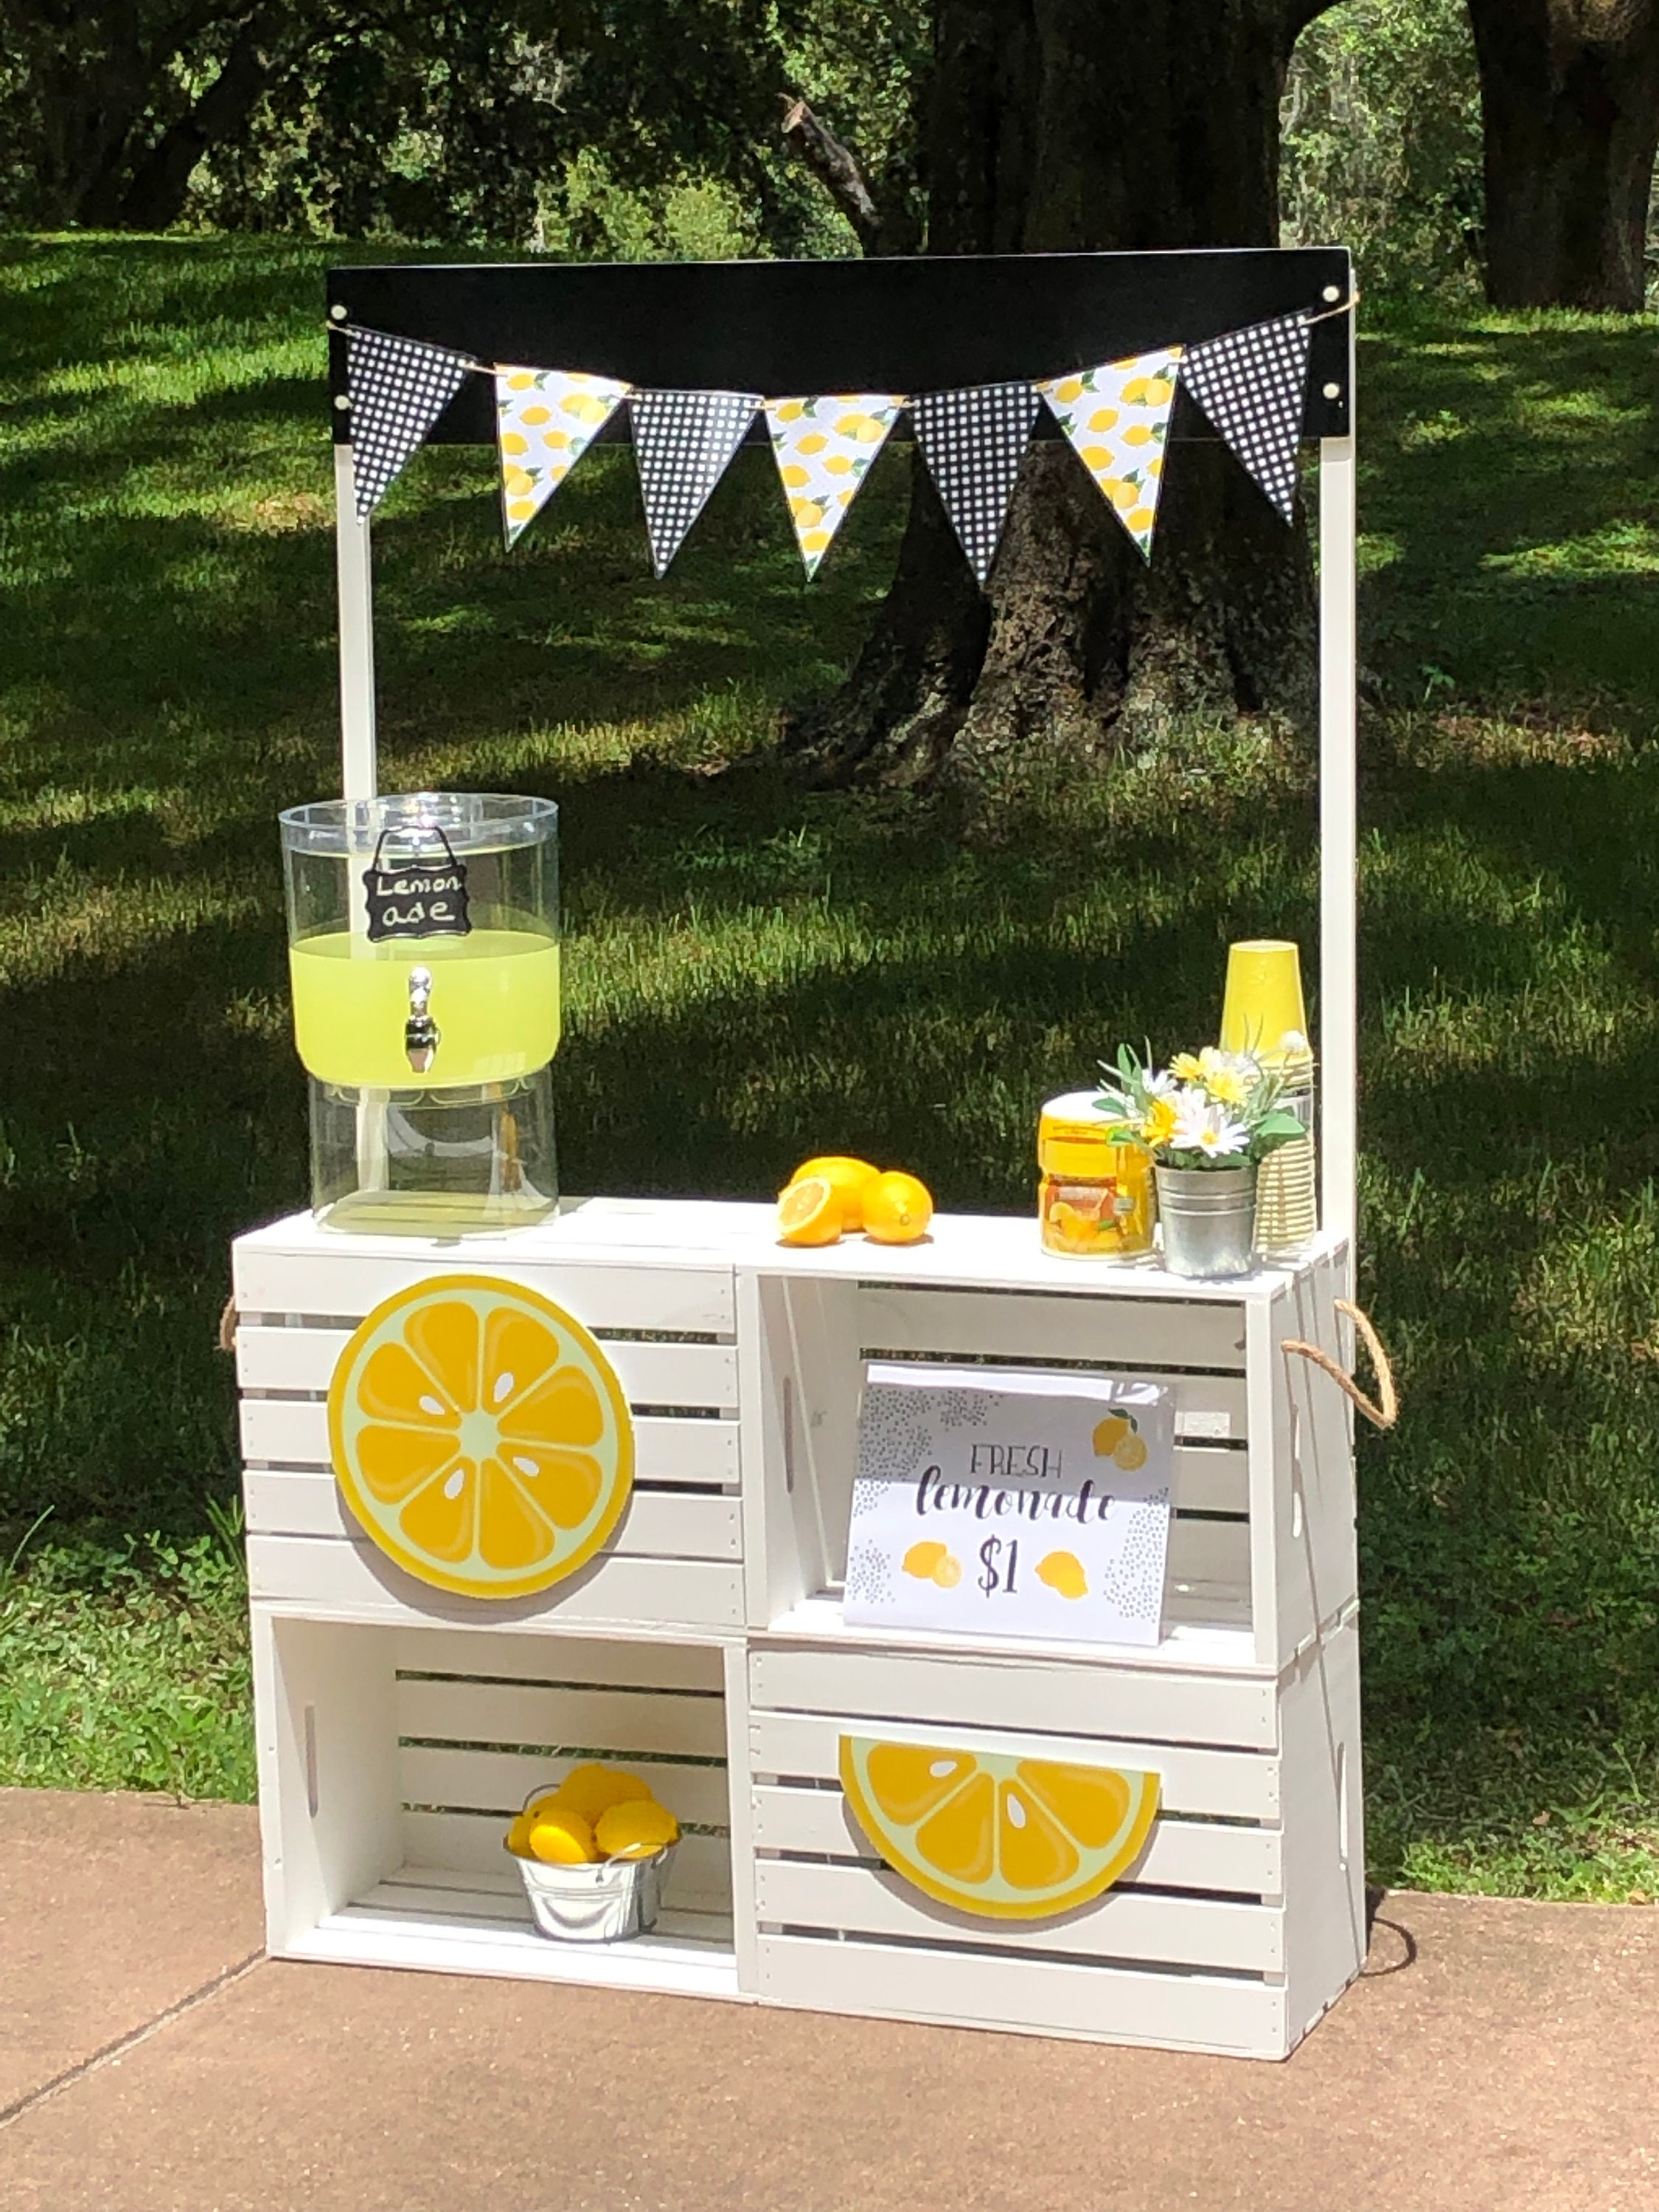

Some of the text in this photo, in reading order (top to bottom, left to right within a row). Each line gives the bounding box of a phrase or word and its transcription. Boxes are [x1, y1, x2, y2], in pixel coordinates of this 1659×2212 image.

[377, 875, 462, 897] Lemon
[383, 902, 455, 927] ade
[971, 1444, 1063, 1479] FRESH
[916, 1464, 1118, 1525] lemonade
[977, 1534, 1018, 1599] $1
